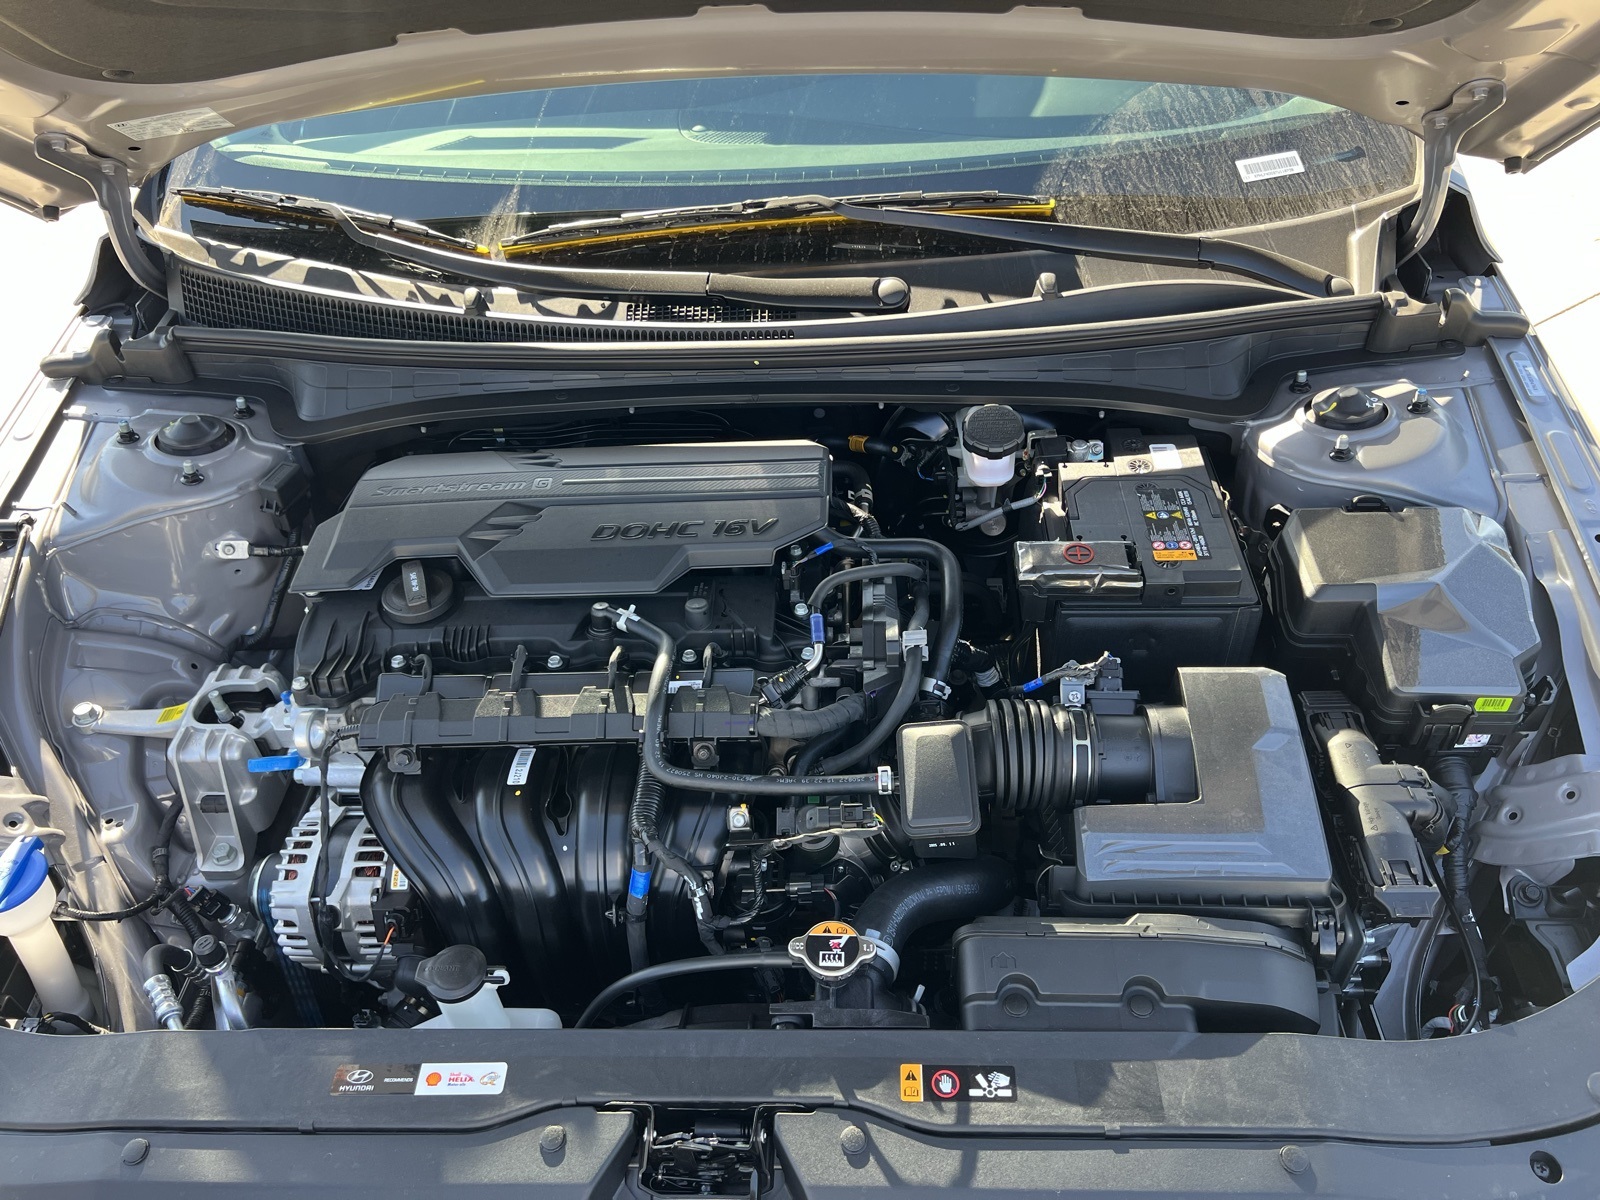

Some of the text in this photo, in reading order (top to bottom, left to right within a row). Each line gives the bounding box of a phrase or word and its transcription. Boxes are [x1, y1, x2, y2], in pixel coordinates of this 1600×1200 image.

[371, 480, 528, 497] Smartstream
[590, 517, 779, 541] DOHC 16V
[862, 943, 873, 952] 1.1
[339, 1084, 375, 1092] HYUNDAI
